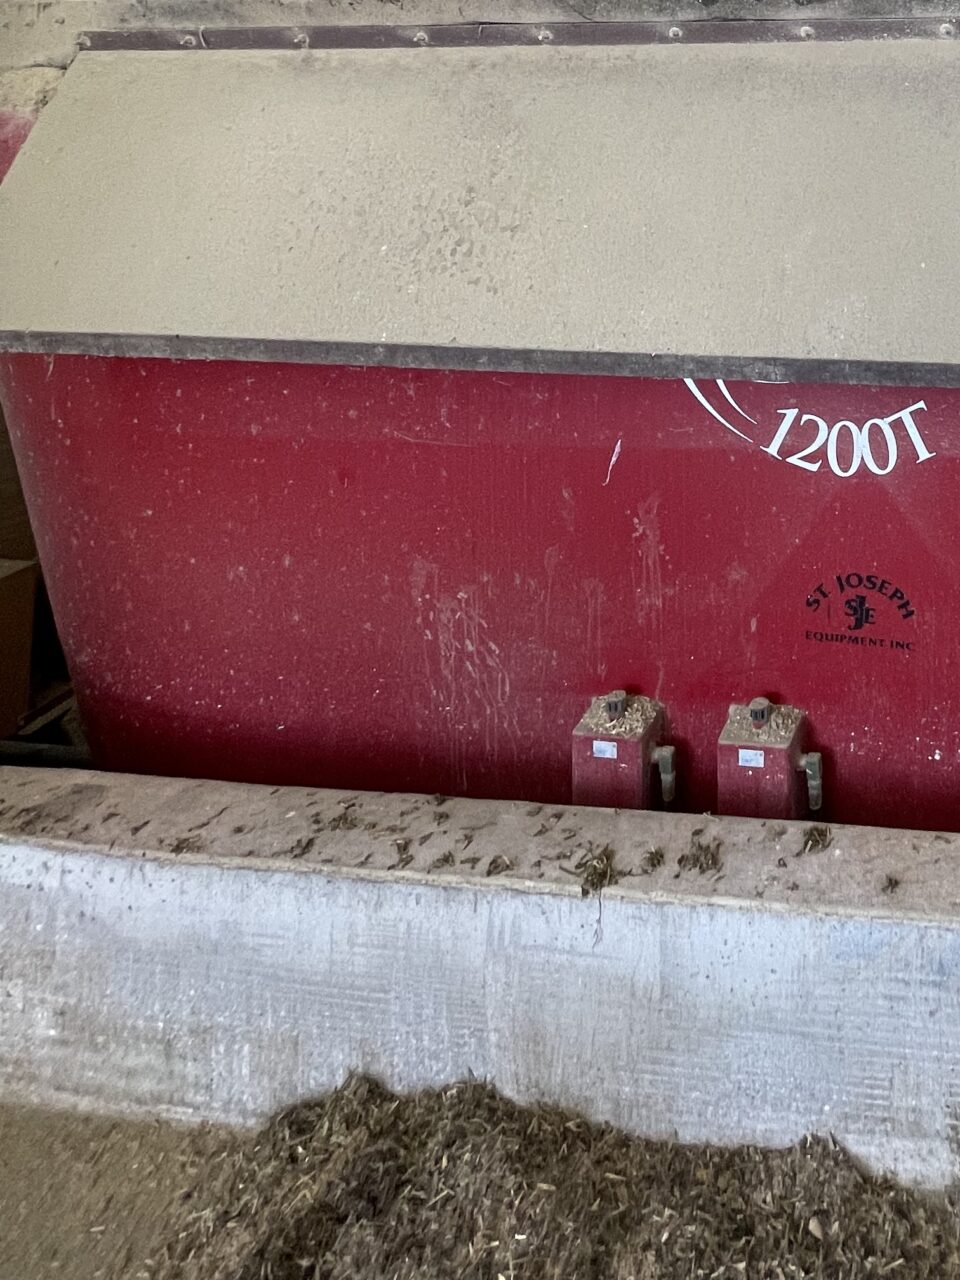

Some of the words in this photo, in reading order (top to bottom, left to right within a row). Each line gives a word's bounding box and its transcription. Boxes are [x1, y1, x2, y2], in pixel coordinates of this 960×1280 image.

[759, 400, 936, 477] 1200T
[835, 572, 915, 620] JOSEPH
[805, 630, 885, 648] EQUIPMENT
